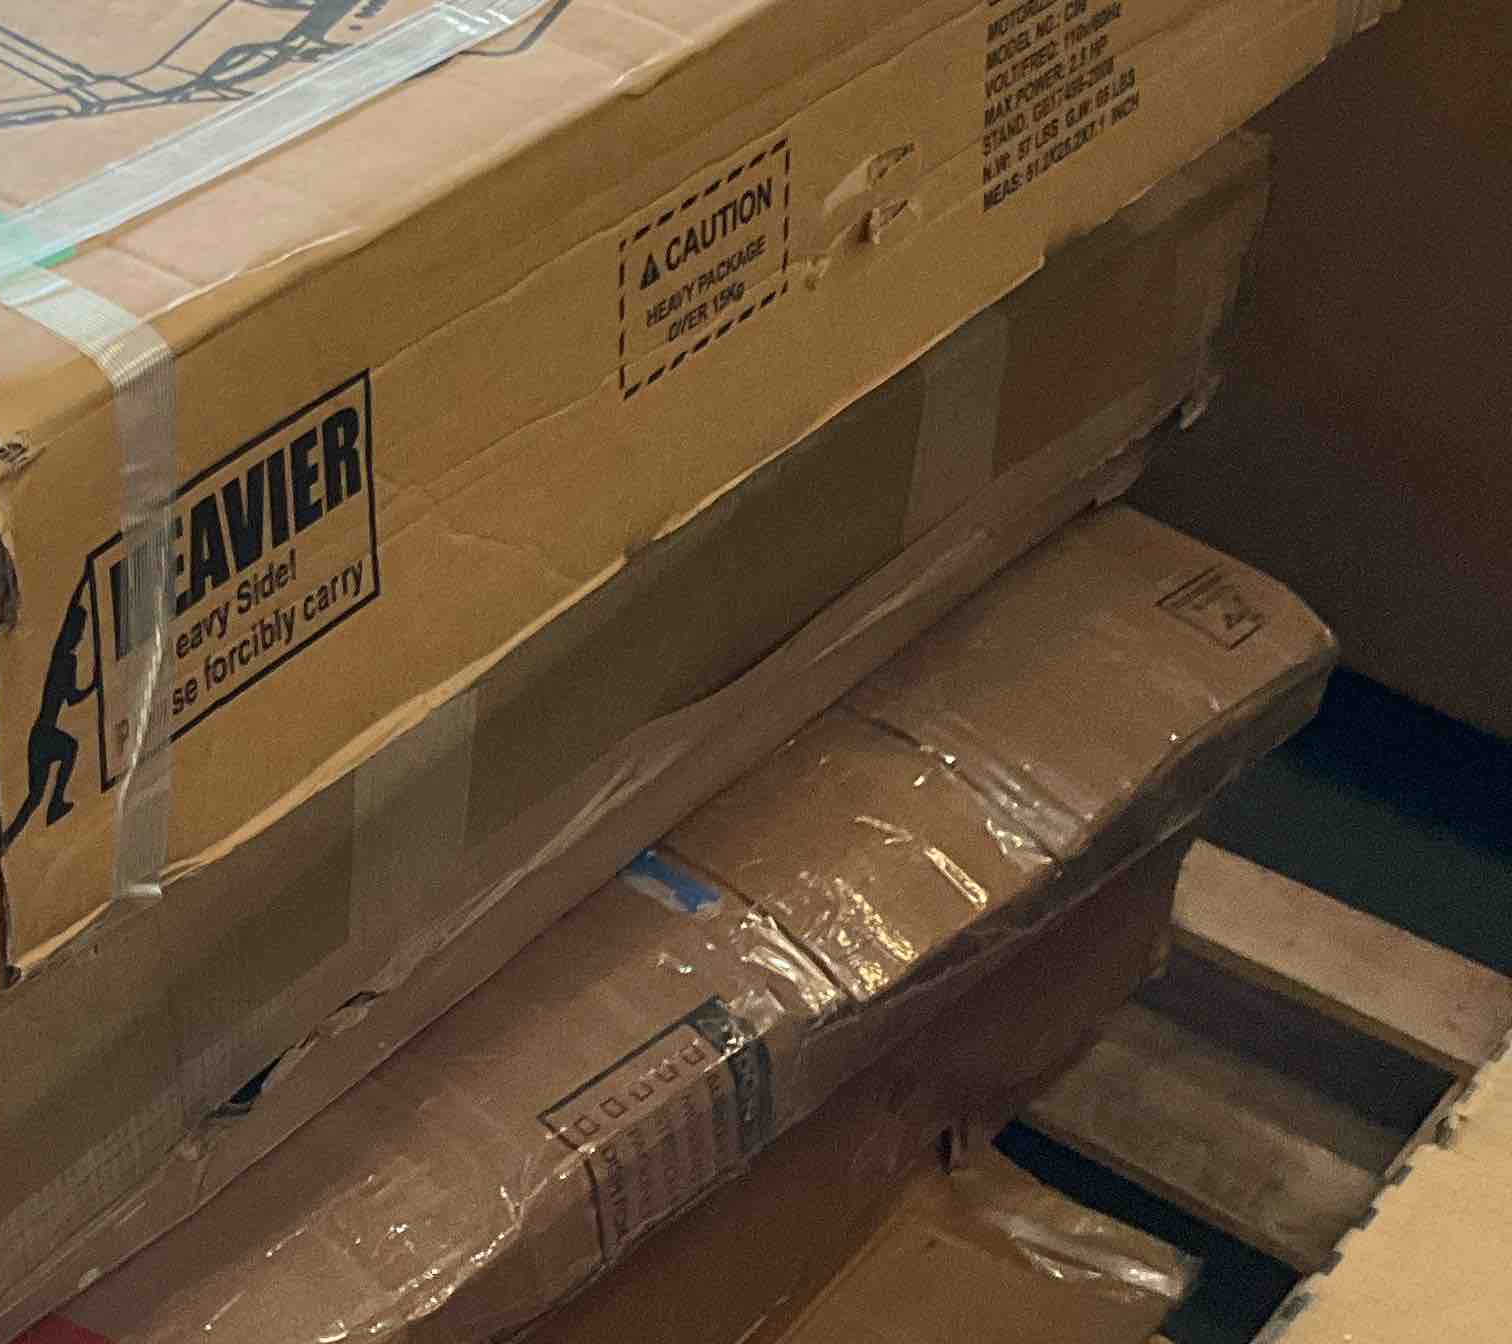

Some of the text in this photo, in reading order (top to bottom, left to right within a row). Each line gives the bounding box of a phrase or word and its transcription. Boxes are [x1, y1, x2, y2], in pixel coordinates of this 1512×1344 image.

[985, 29, 1032, 73] MODEL
[984, 93, 1015, 130] MAX
[1035, 118, 1060, 149] LBS
[1112, 66, 1137, 98] LBS
[665, 177, 773, 272] CAUTION
[646, 234, 767, 329] HEAVY PACKAGE
[667, 301, 709, 343] OVER
[175, 601, 232, 660] eavy
[203, 604, 297, 692] forcibly
[302, 559, 364, 623] carry
